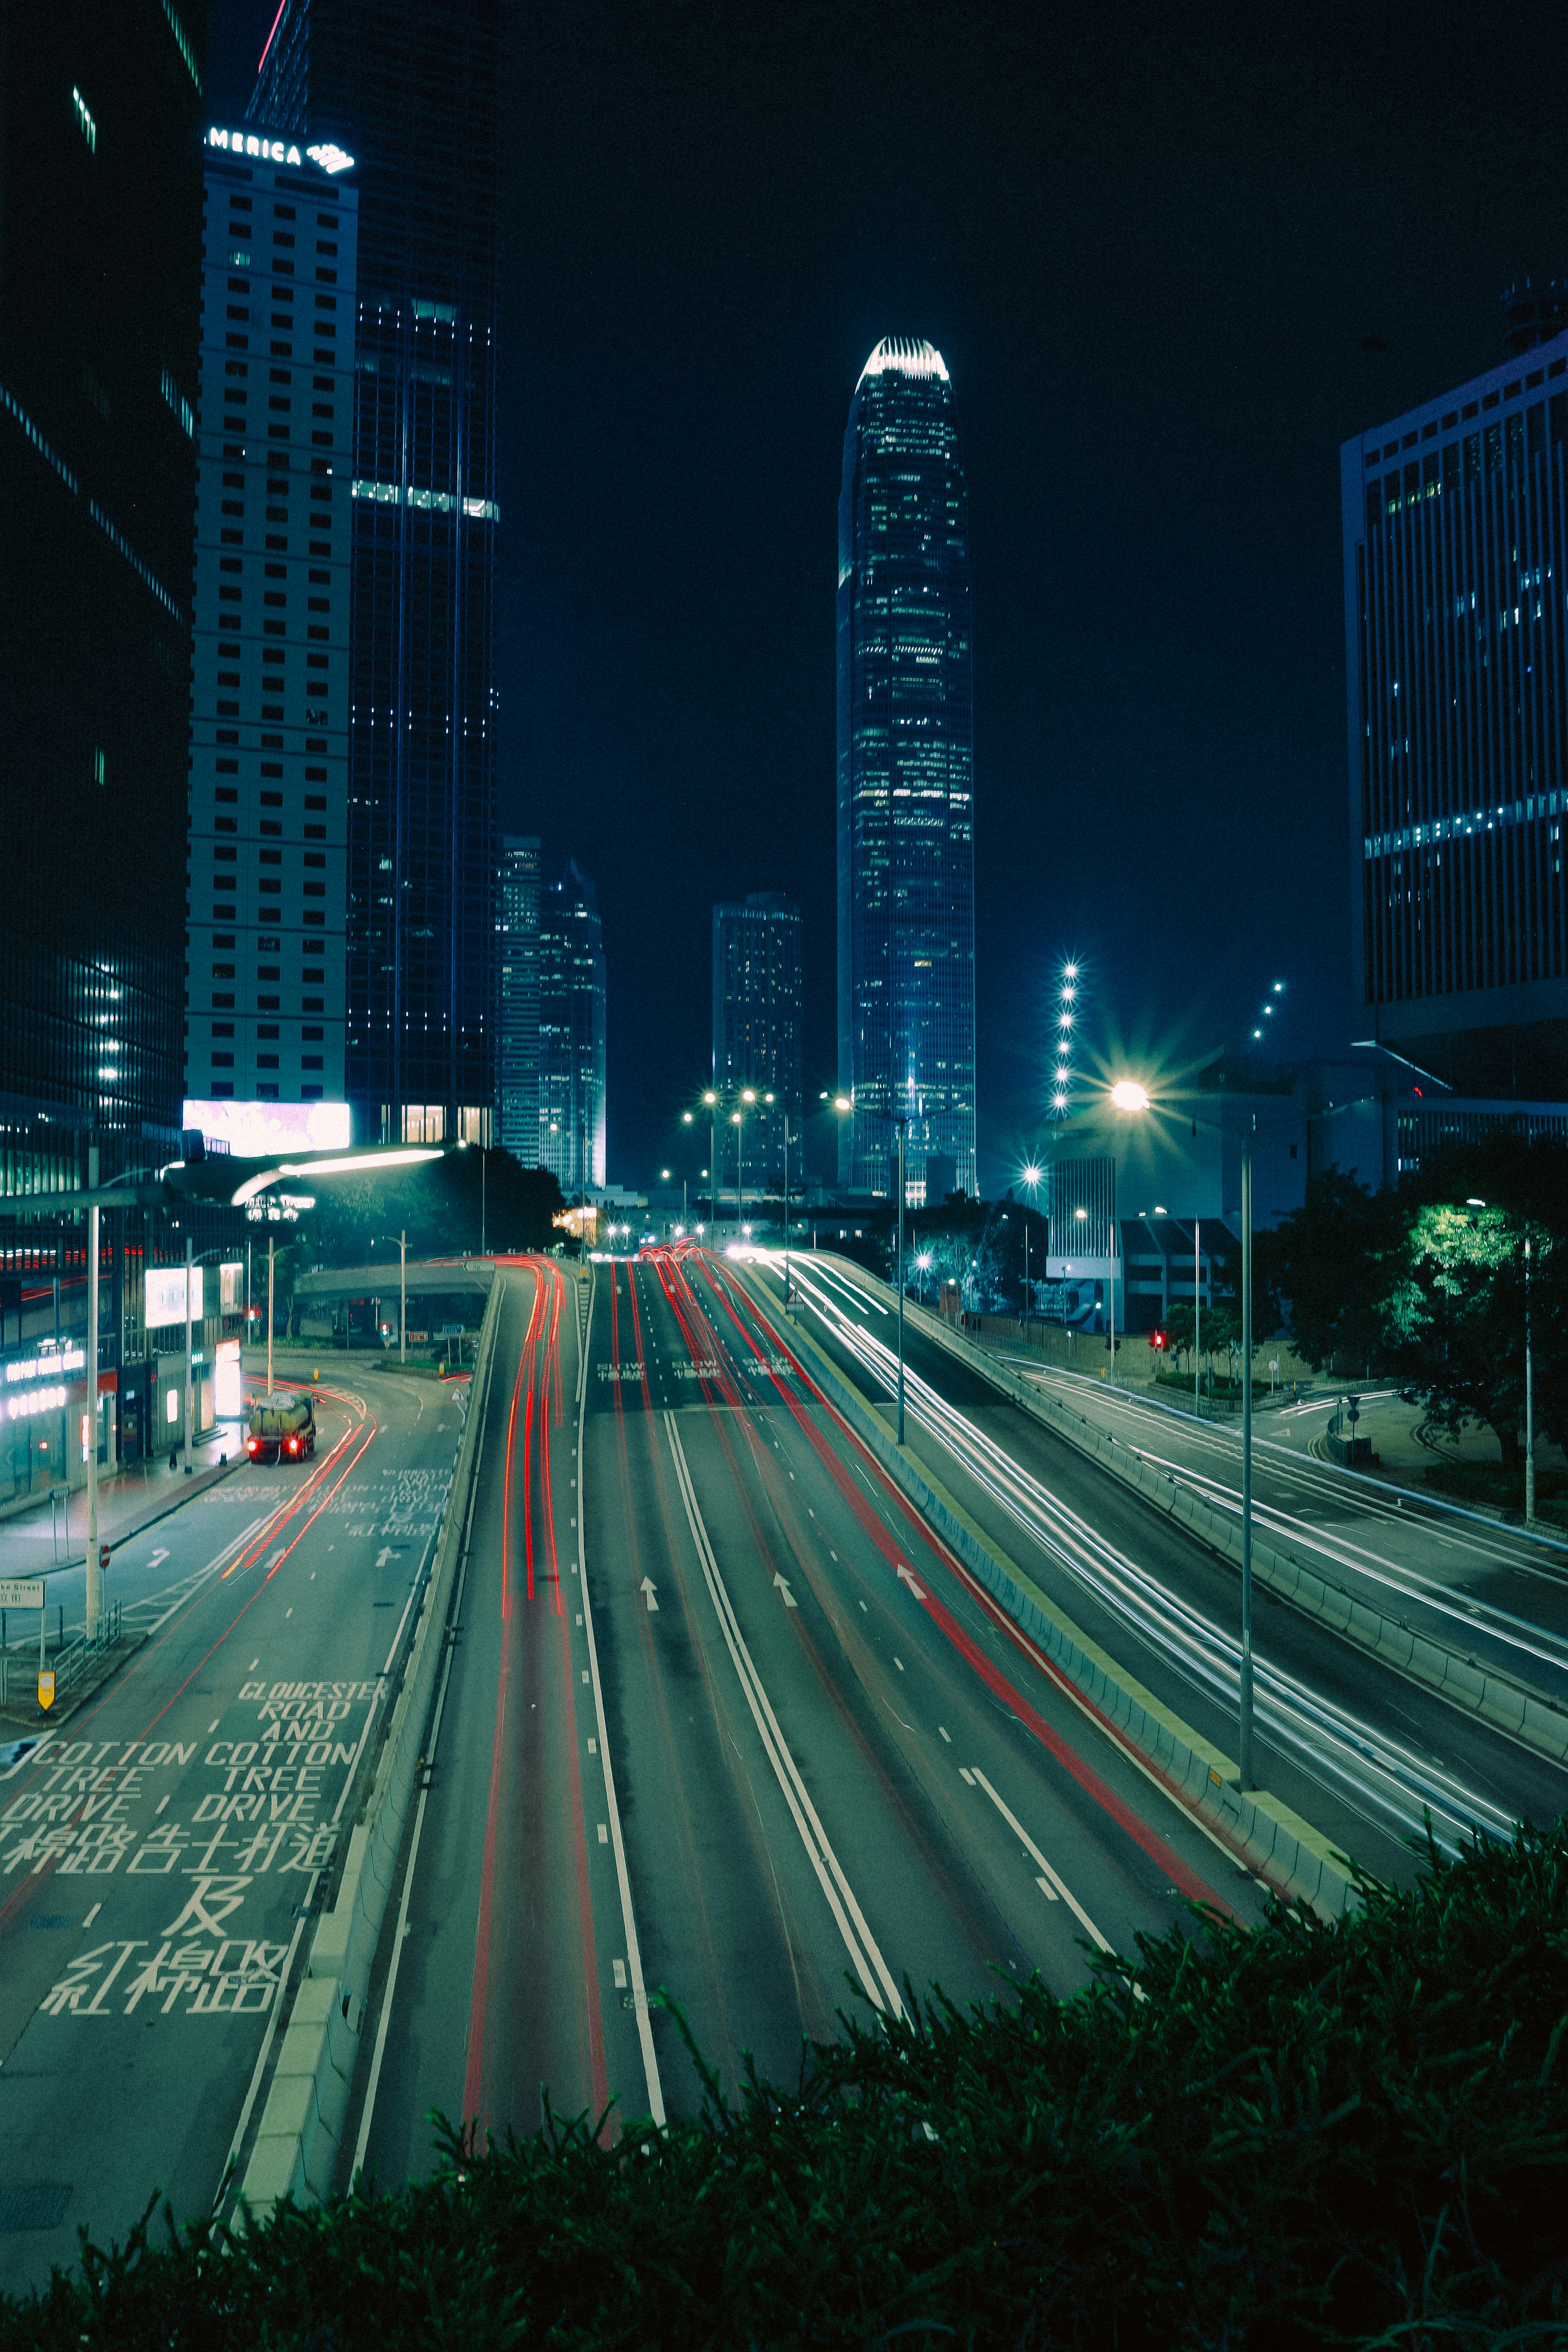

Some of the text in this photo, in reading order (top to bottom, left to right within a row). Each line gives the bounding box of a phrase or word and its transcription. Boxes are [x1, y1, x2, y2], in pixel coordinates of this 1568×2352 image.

[204, 127, 301, 166] MERICA
[597, 1362, 644, 1370] SLOW
[672, 1360, 717, 1368] SLOW
[742, 1357, 789, 1367] SLOW
[14, 1583, 40, 1592] Street
[238, 1681, 389, 1700] GLOUCESTER
[257, 1700, 351, 1720] ROAD
[260, 1720, 335, 1741] AND
[32, 1742, 198, 1766] COTTON
[204, 1742, 357, 1766] COTTON
[42, 1767, 155, 1792] TREE
[223, 1767, 325, 1792] TREE
[2, 1794, 141, 1822] DRIVE
[192, 1794, 321, 1822] DRIVE
[125, 1820, 341, 1873] 告士打道
[161, 1876, 254, 1937] 及
[39, 1940, 289, 2015] 紅棉路
